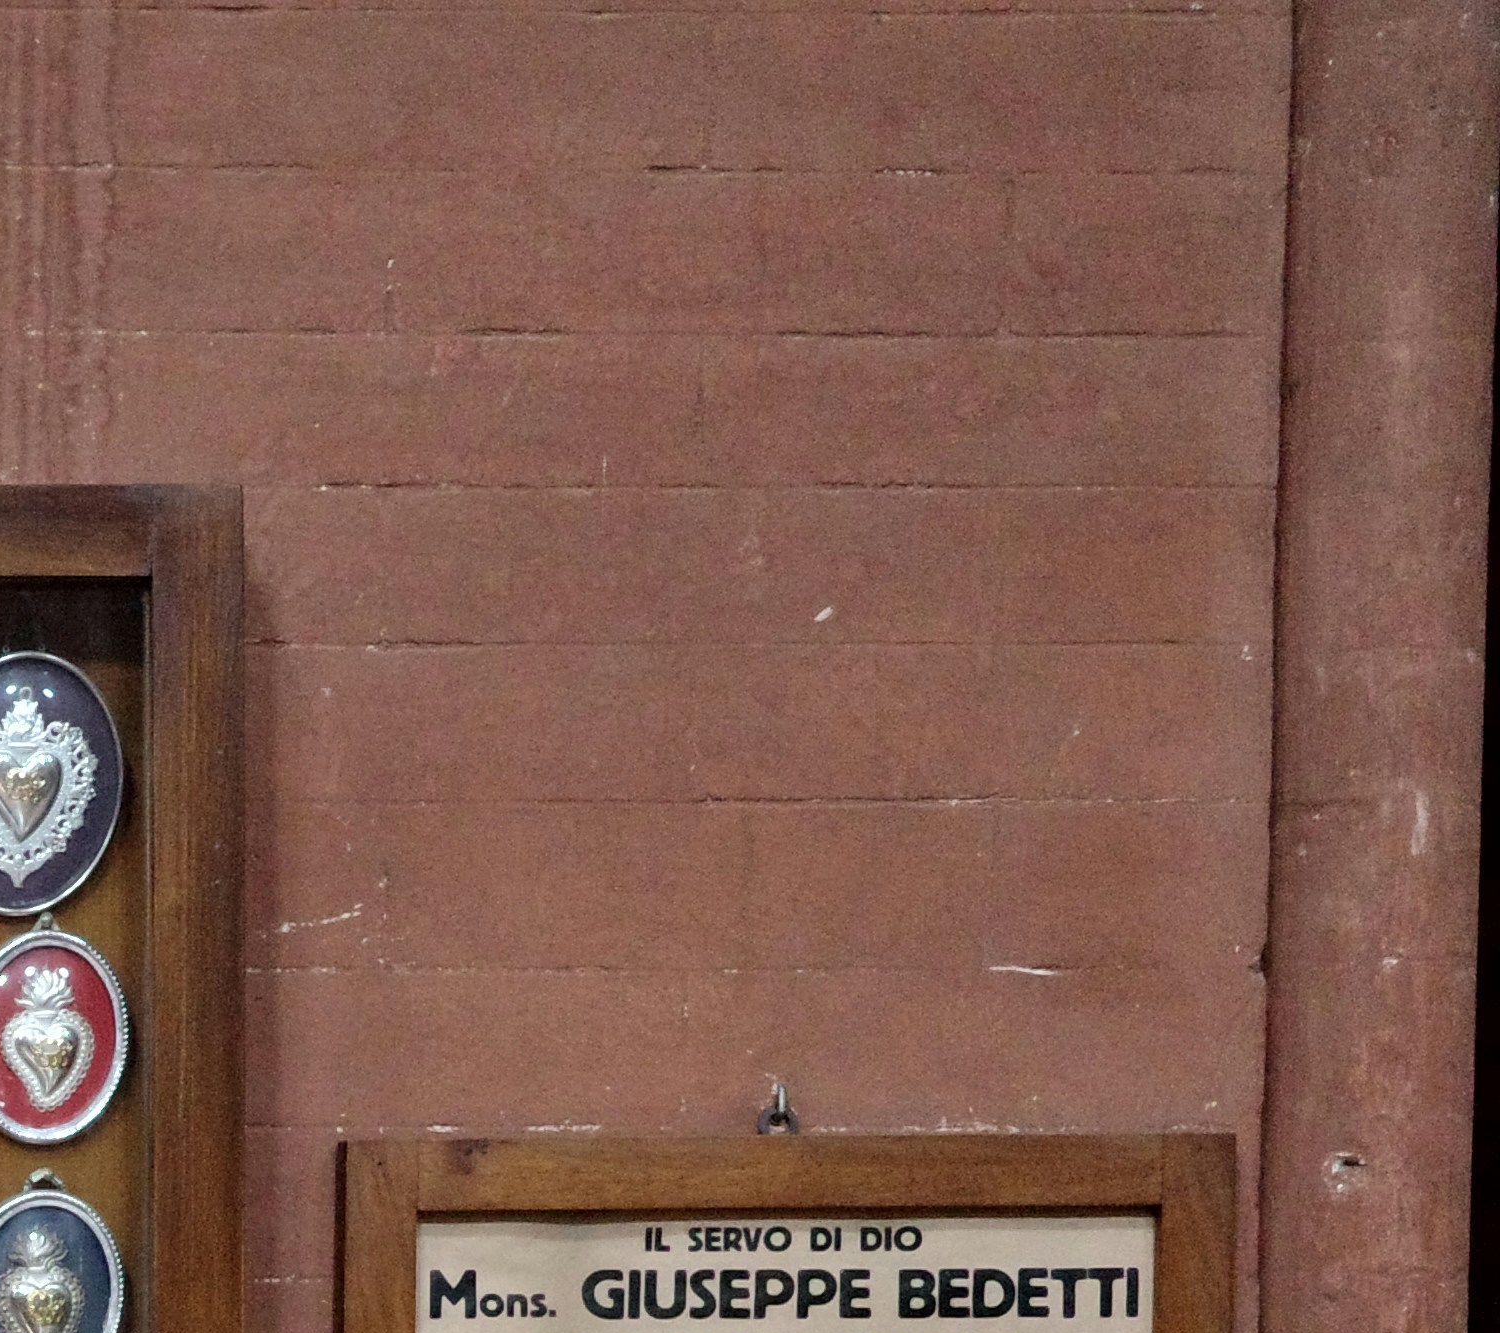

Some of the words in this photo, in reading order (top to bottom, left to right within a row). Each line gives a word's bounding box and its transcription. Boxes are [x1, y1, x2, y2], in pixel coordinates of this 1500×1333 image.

[643, 1225, 671, 1253] IL
[686, 1224, 793, 1253] SERVO
[809, 1225, 843, 1252] DI
[858, 1224, 923, 1252] DIO
[428, 1268, 557, 1320] Mons.
[580, 1267, 872, 1321] GIUSEPPE
[897, 1266, 1140, 1320] BEDETTI
